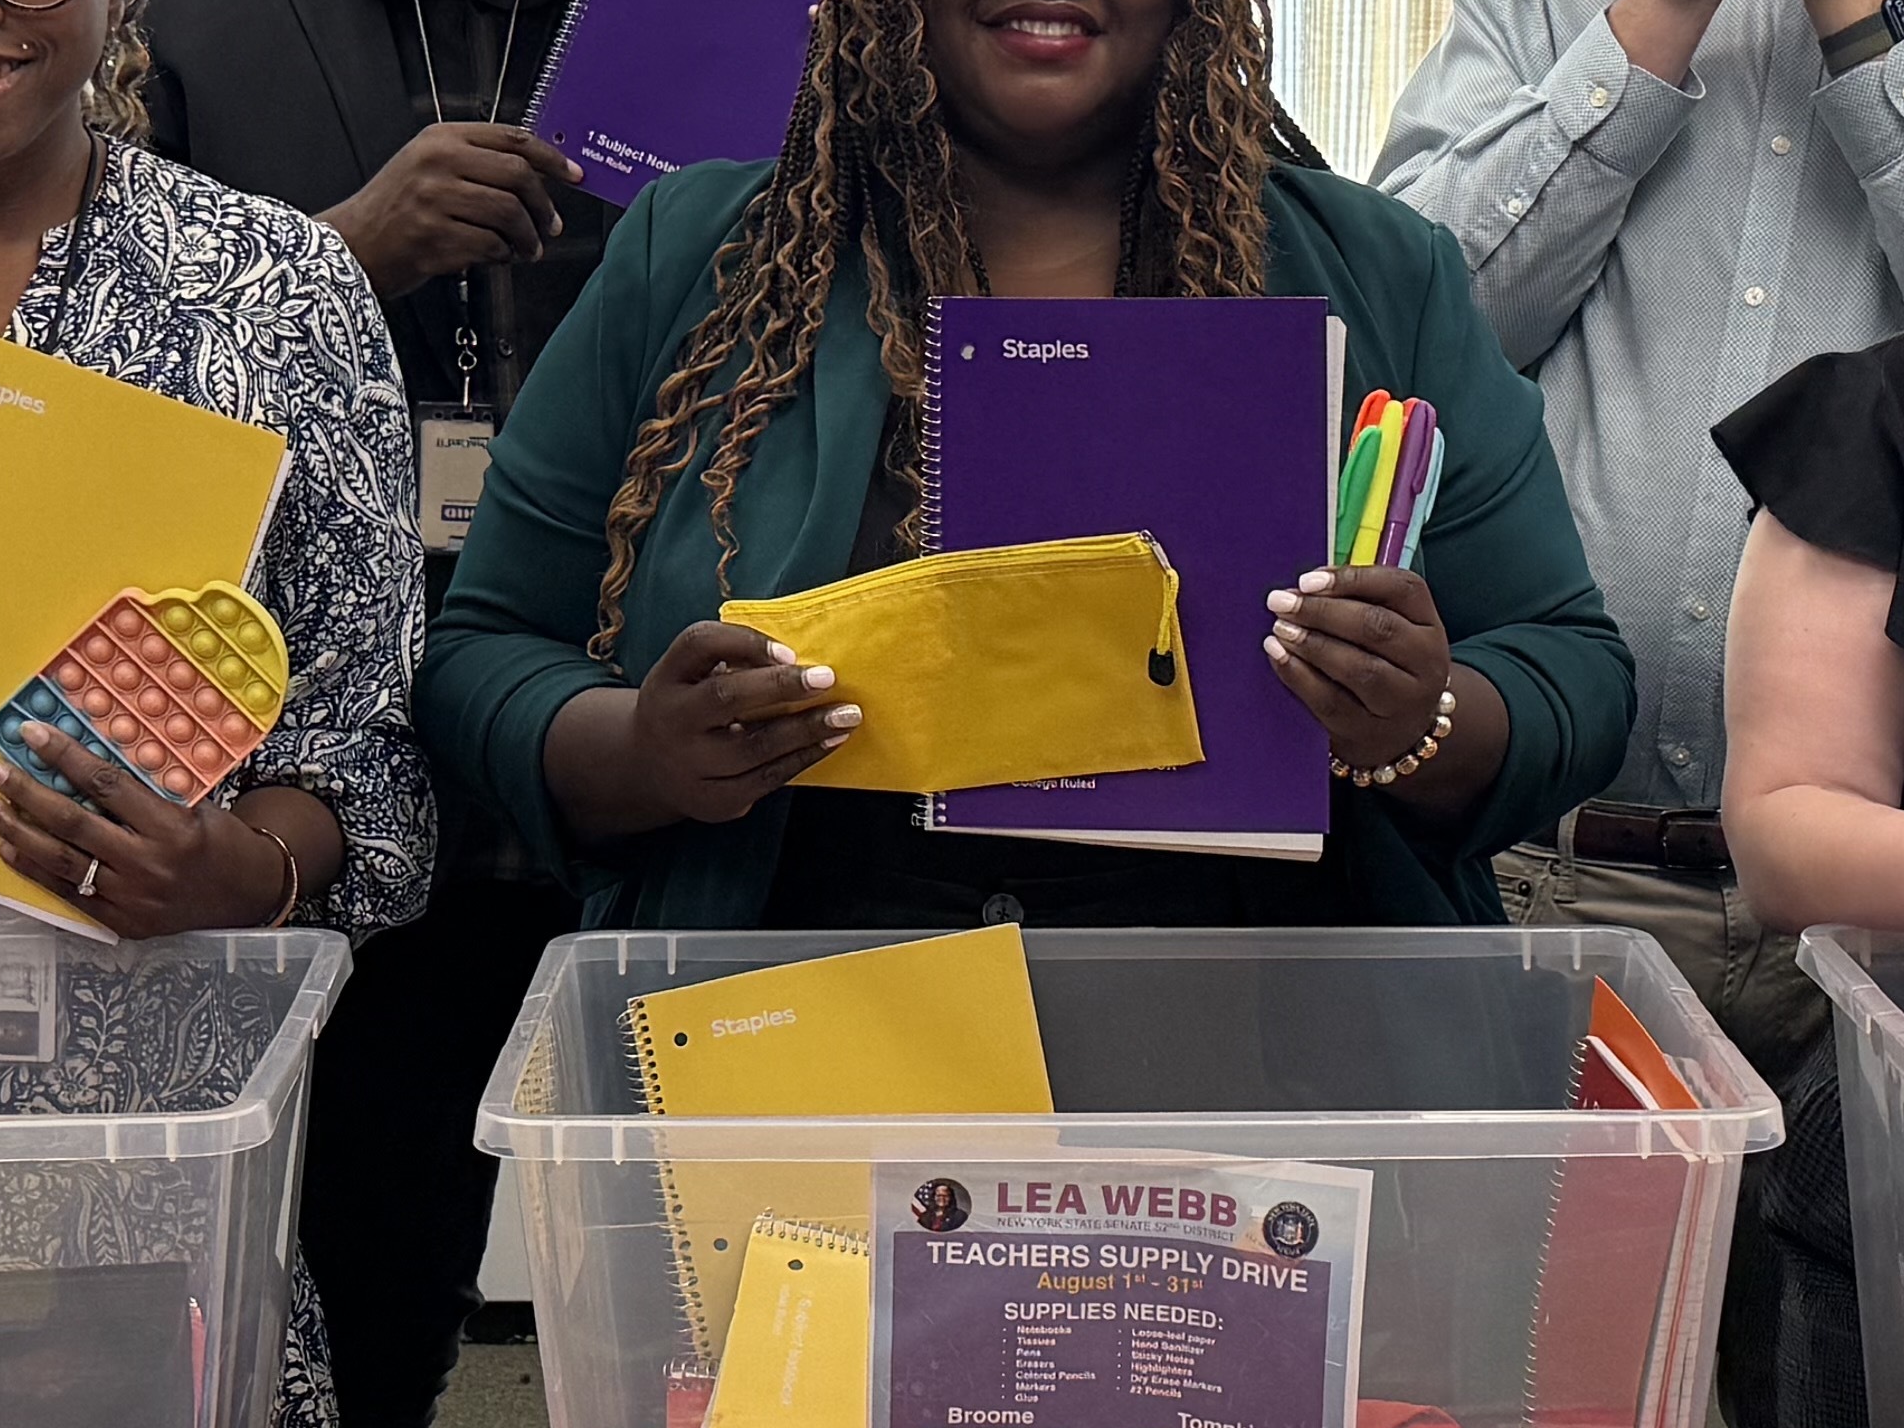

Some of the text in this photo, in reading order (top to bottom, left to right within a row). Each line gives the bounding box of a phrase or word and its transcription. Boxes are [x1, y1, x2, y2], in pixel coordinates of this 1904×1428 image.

[587, 130, 644, 165] 1 Subject
[1002, 338, 1090, 362] Staples
[710, 1006, 797, 1039] Staples
[996, 1182, 1238, 1228] LEA WEBB
[996, 1218, 1027, 1229] NEW
[1027, 1218, 1063, 1230] YORK
[1065, 1218, 1102, 1230] STATE
[1103, 1219, 1152, 1232] SENATE
[1183, 1225, 1236, 1242] DISTRICT
[926, 1241, 1309, 1293] TEACHERS SUPPLY DRIVE
[1037, 1272, 1115, 1295] August
[1004, 1302, 1224, 1331] SUPPLIES NEEDED:
[948, 1407, 1035, 1425] Broome
